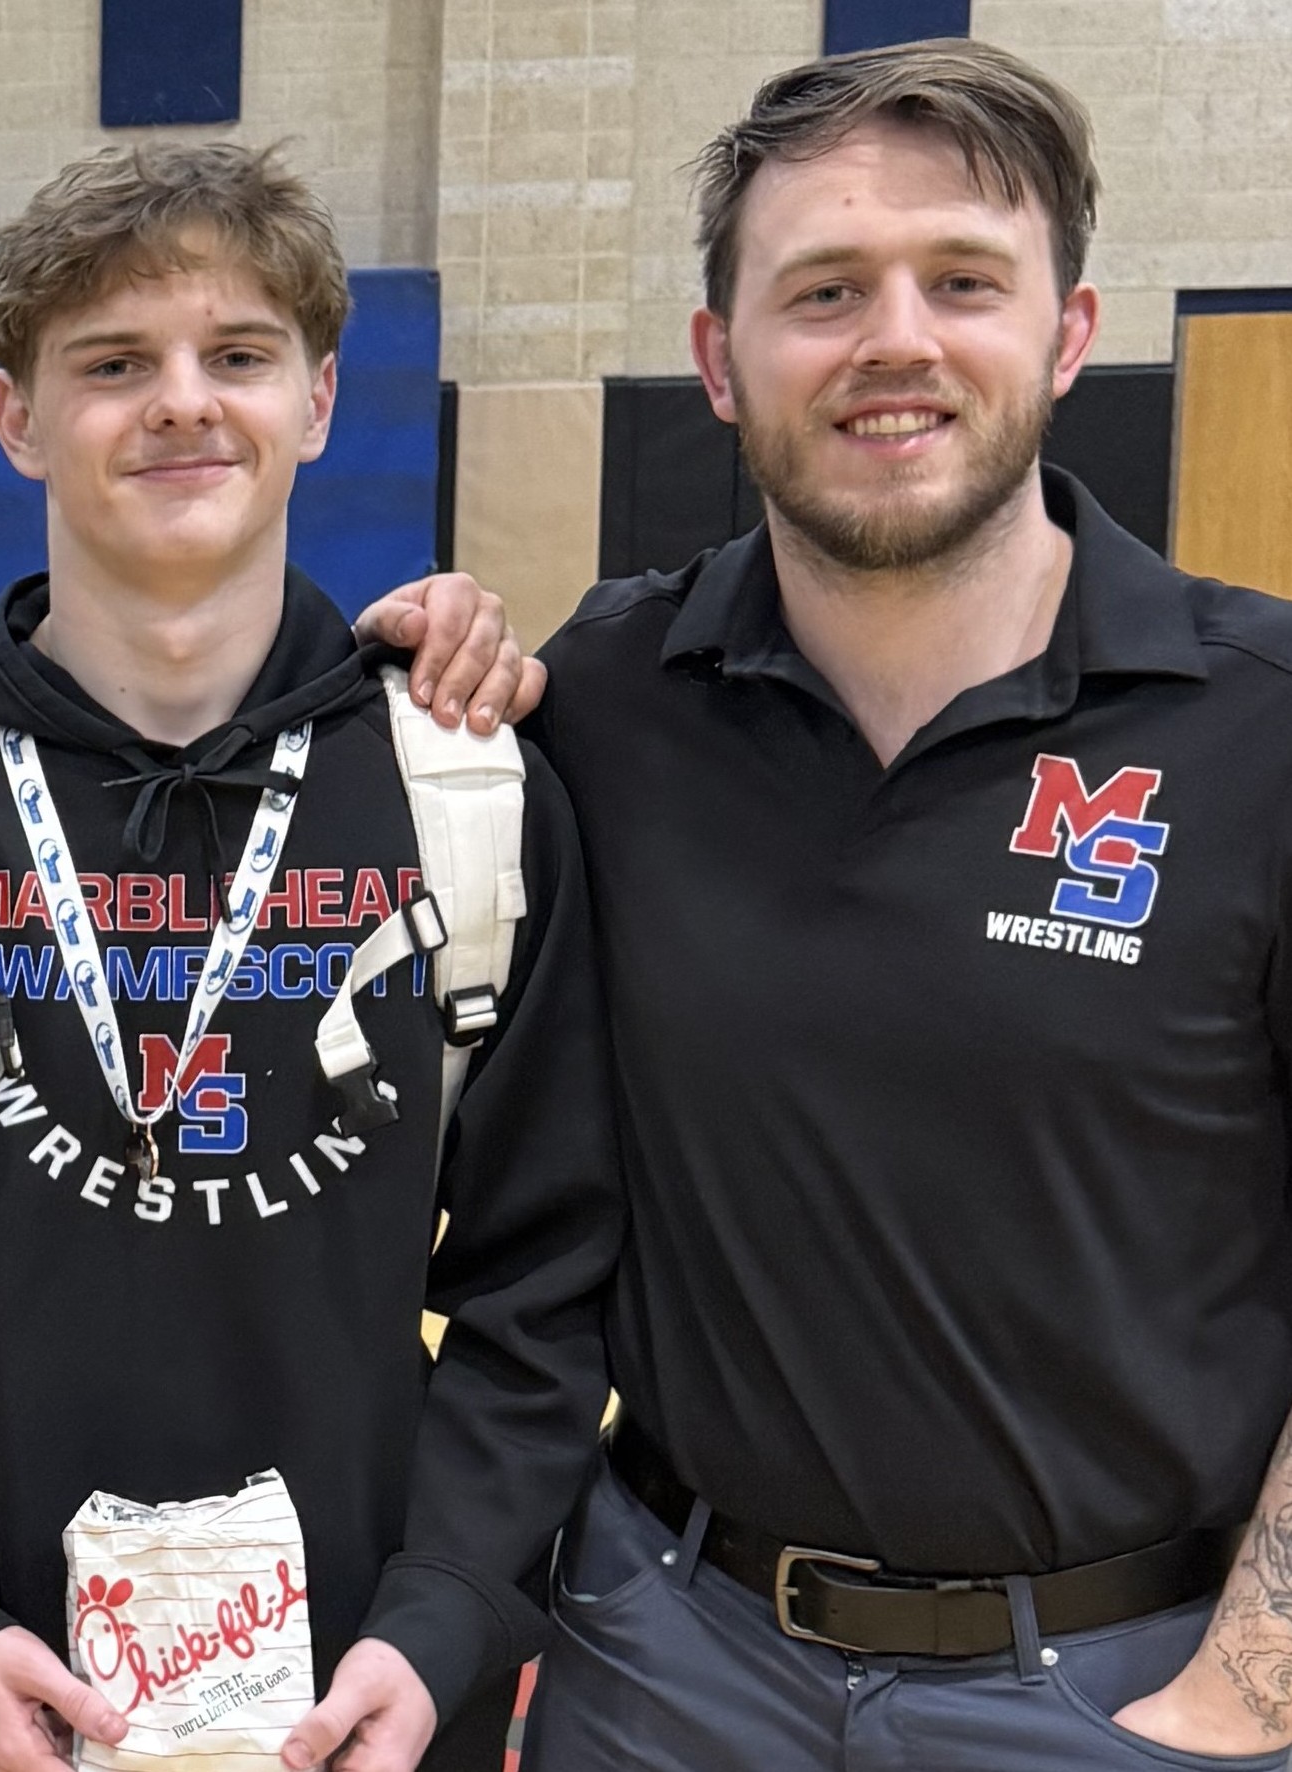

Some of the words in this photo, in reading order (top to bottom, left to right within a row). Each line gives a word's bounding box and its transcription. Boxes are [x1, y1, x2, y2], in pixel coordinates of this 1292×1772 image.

[1009, 753, 1170, 928] MS
[985, 911, 1143, 965] WRESTLING
[138, 1034, 248, 1154] MS
[199, 1679, 234, 1705] TASTE
